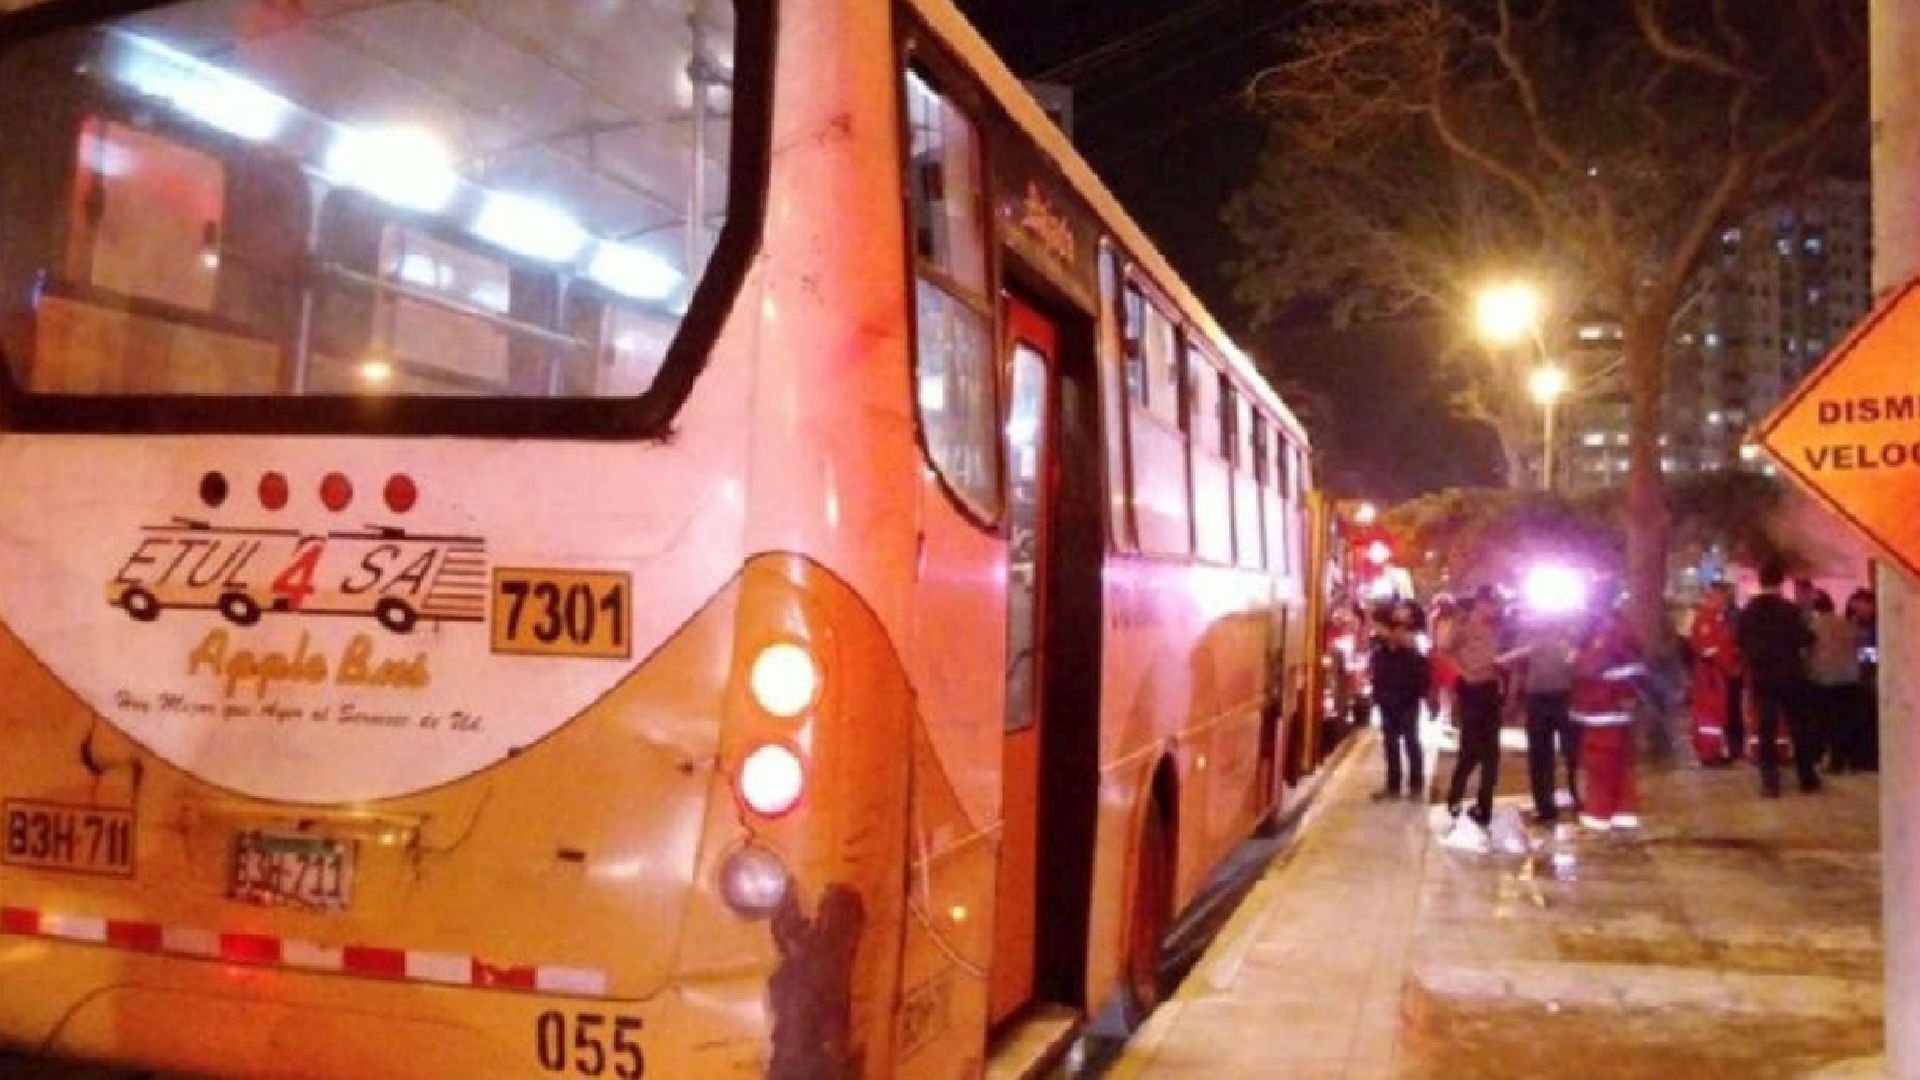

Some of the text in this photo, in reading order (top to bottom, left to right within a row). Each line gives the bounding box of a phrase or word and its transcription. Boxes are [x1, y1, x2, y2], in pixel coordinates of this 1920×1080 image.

[1818, 394, 1920, 424] DISM
[114, 535, 438, 612] ETUL 4 SA
[501, 580, 629, 647] 7301
[188, 628, 328, 699] Apple
[8, 809, 130, 866] B3H-711
[536, 1010, 645, 1080] 055
